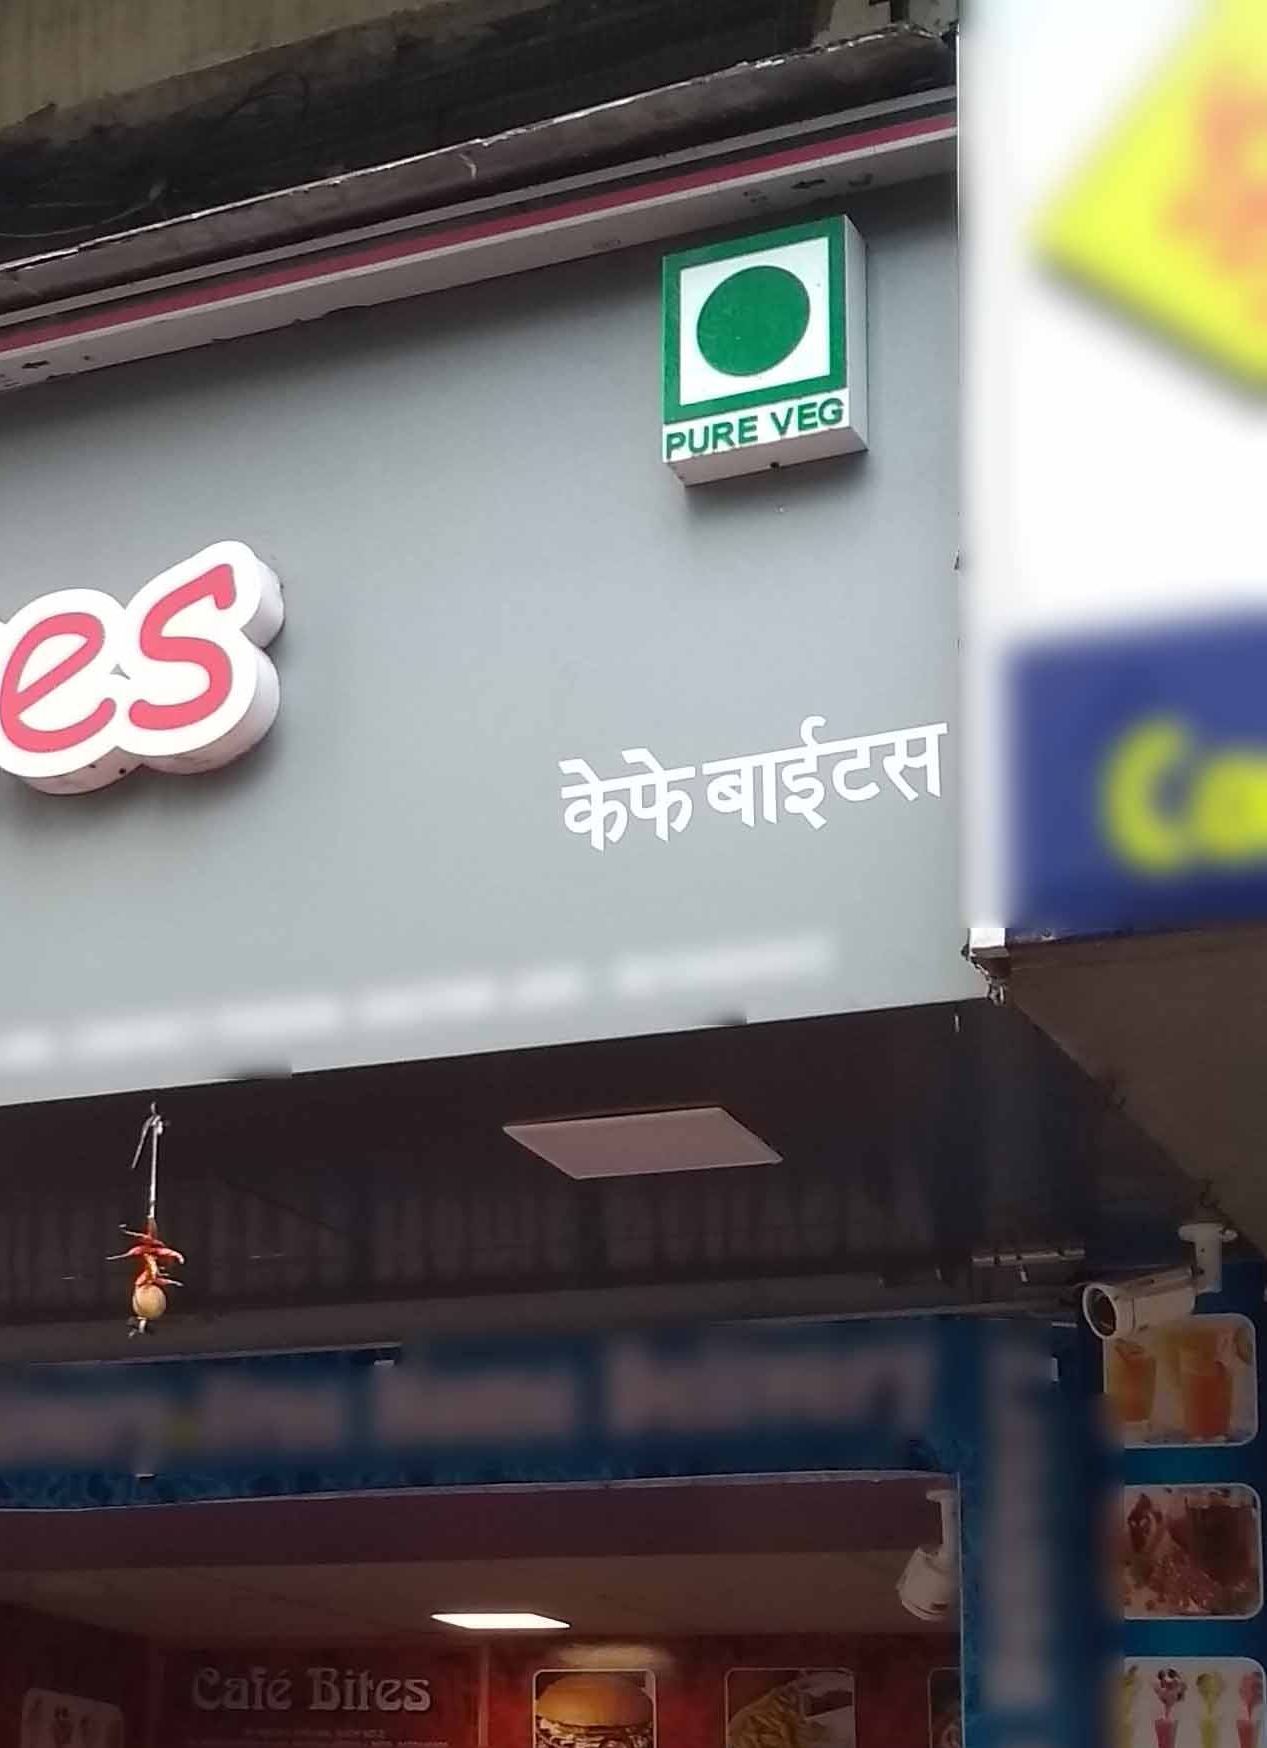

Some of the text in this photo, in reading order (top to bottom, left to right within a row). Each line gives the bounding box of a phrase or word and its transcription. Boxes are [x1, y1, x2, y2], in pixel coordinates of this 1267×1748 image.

[665, 397, 844, 459] PURE VEG
[558, 715, 949, 852] केफे बाईटस
[304, 1666, 432, 1712] Bites
